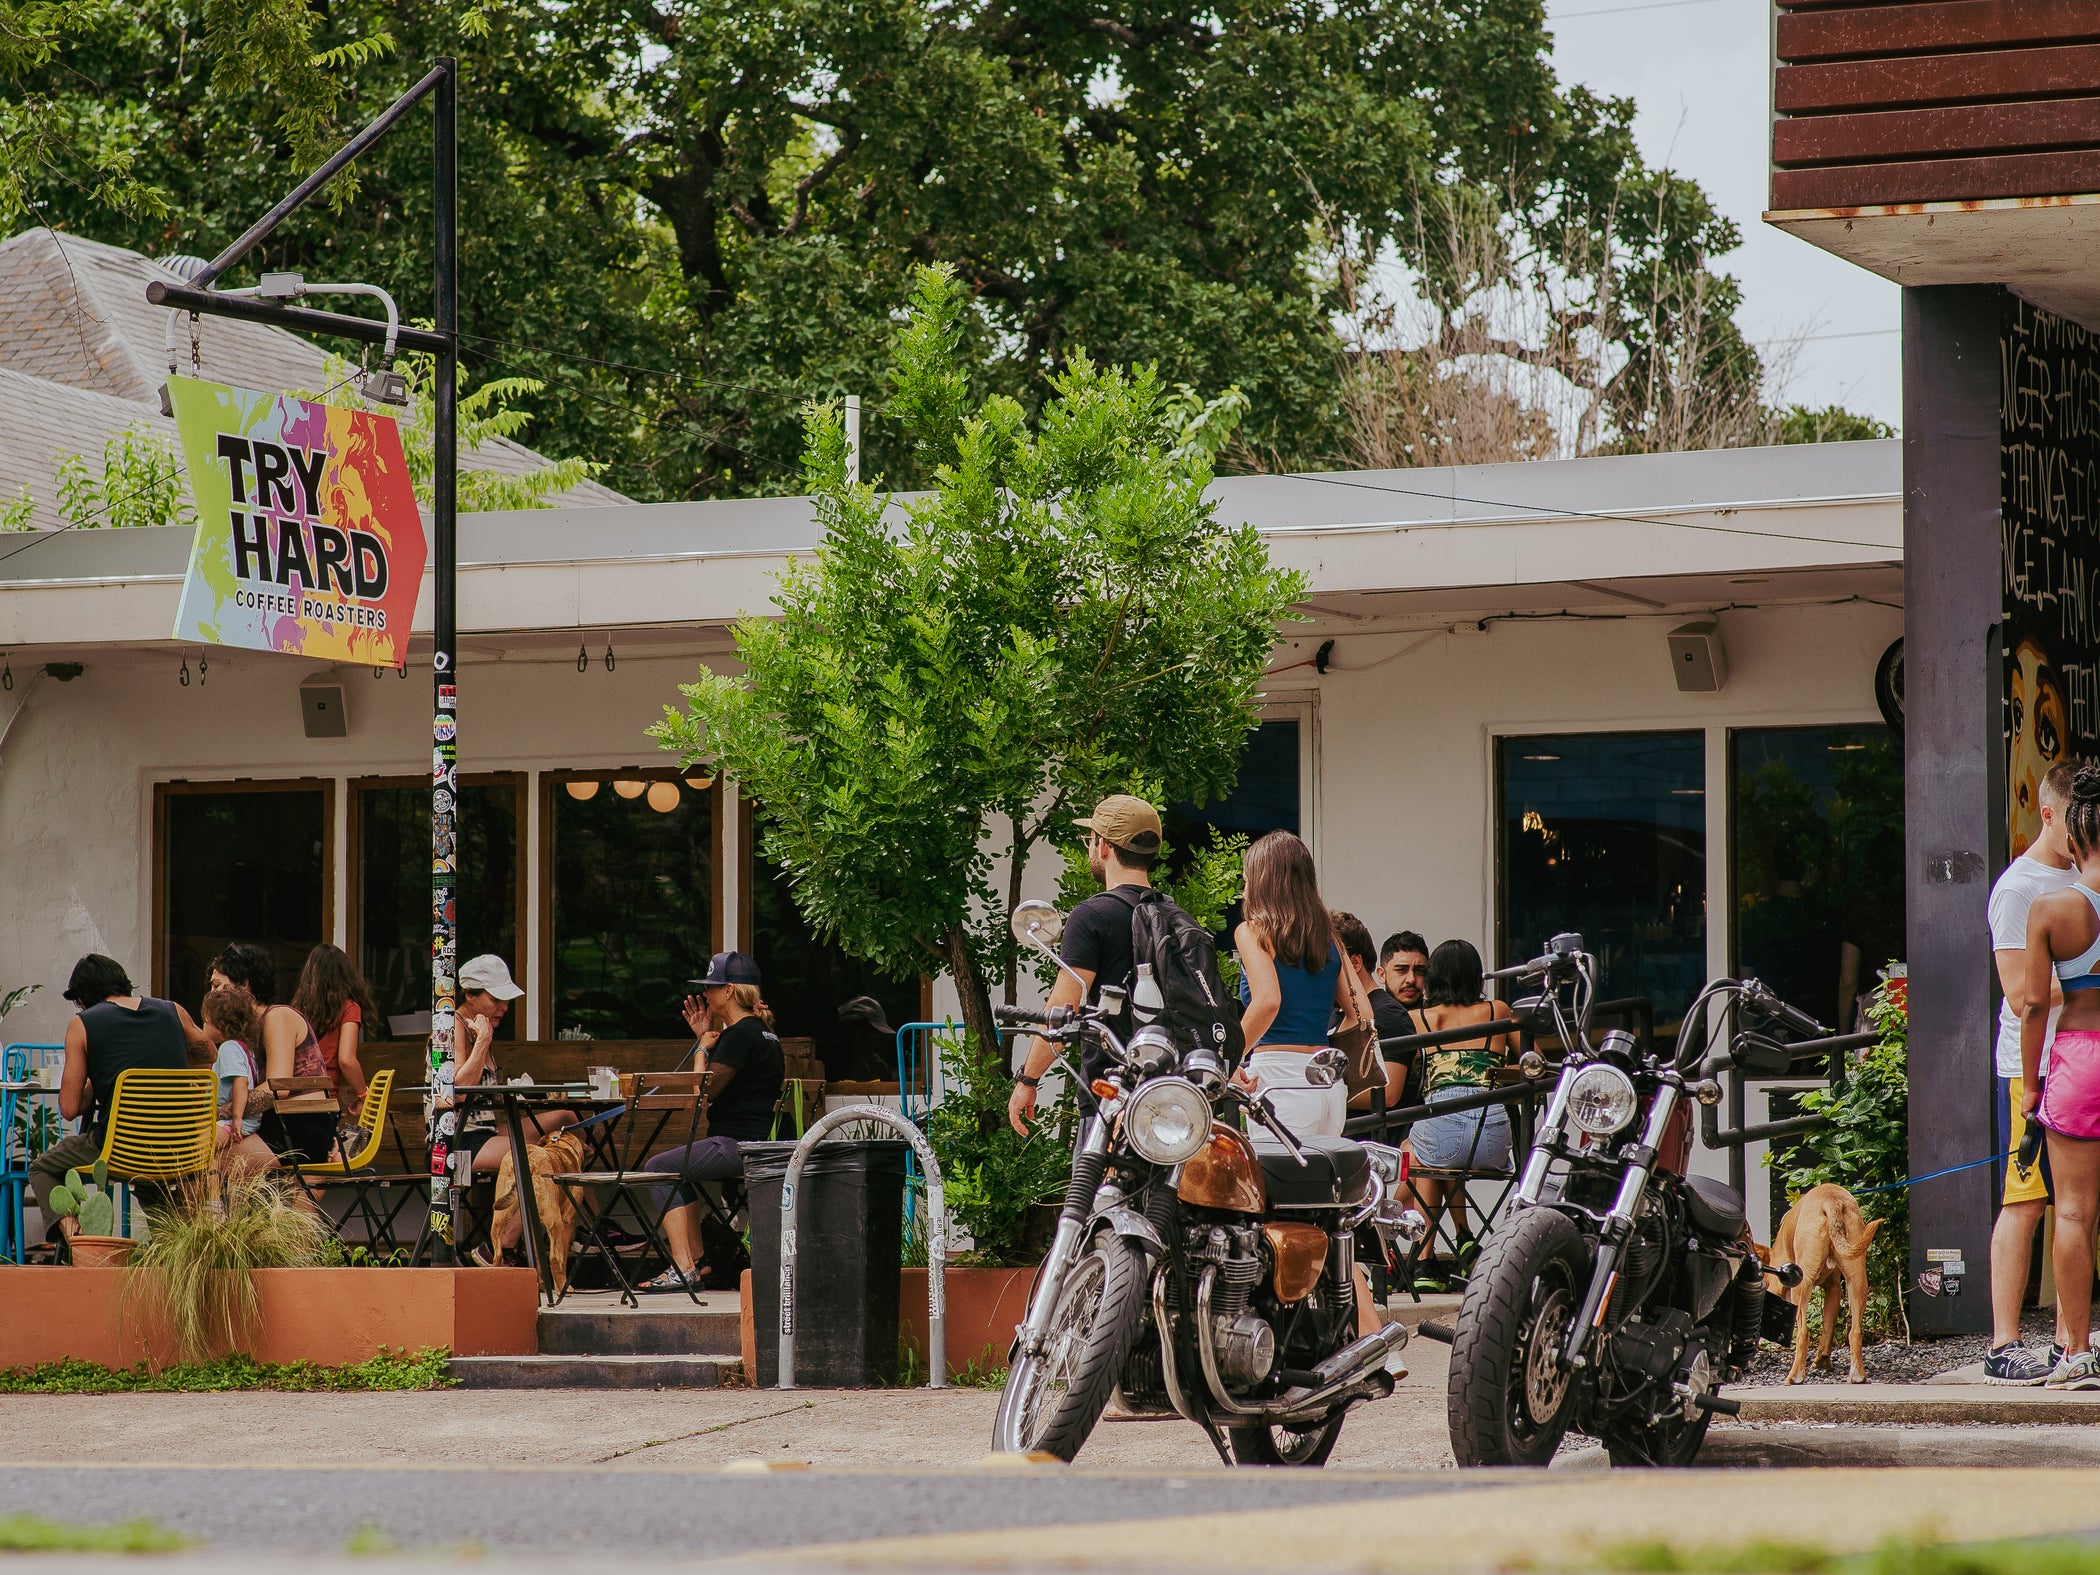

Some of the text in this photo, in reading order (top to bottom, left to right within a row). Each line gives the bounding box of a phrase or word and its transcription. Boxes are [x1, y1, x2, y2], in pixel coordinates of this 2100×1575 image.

[2000, 335, 2100, 449] NGER ACCE
[217, 432, 328, 518] TRY
[2009, 441, 2069, 537] THINGS
[229, 509, 389, 600] HARD
[2001, 518, 2043, 613] NGE.
[236, 590, 388, 629] COFFEE ROASTERS
[2062, 655, 2100, 741] THIN
[783, 1307, 792, 1335] street
